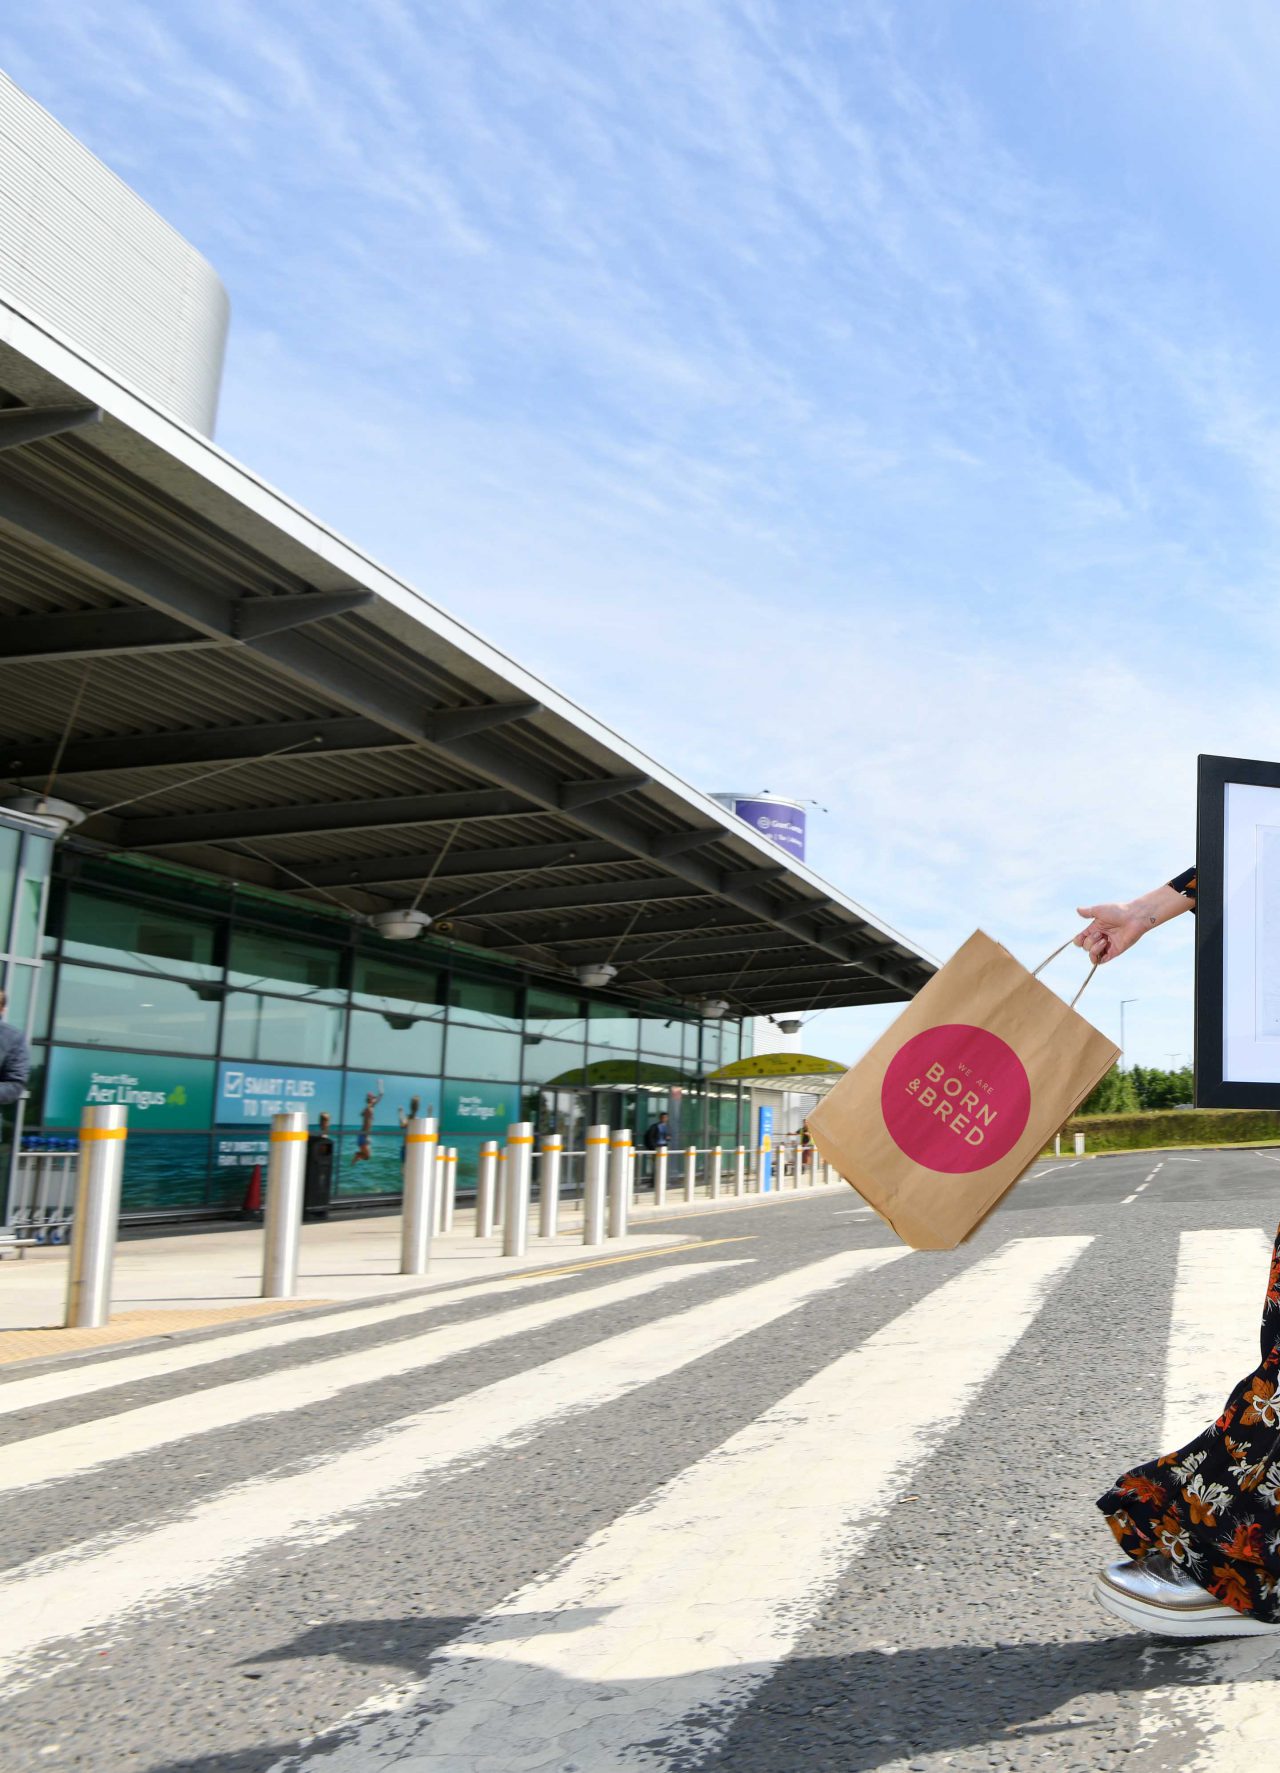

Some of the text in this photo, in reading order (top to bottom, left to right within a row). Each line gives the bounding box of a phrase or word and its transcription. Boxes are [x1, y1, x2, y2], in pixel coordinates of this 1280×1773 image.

[244, 1077, 316, 1097] SMART FLIES
[957, 1062, 995, 1096] WE ARE
[86, 1084, 166, 1109] Aer Lingus
[243, 1099, 258, 1117] TO
[261, 1100, 283, 1117] THE
[925, 1062, 998, 1127] BORN
[908, 1078, 985, 1146] & BRED
